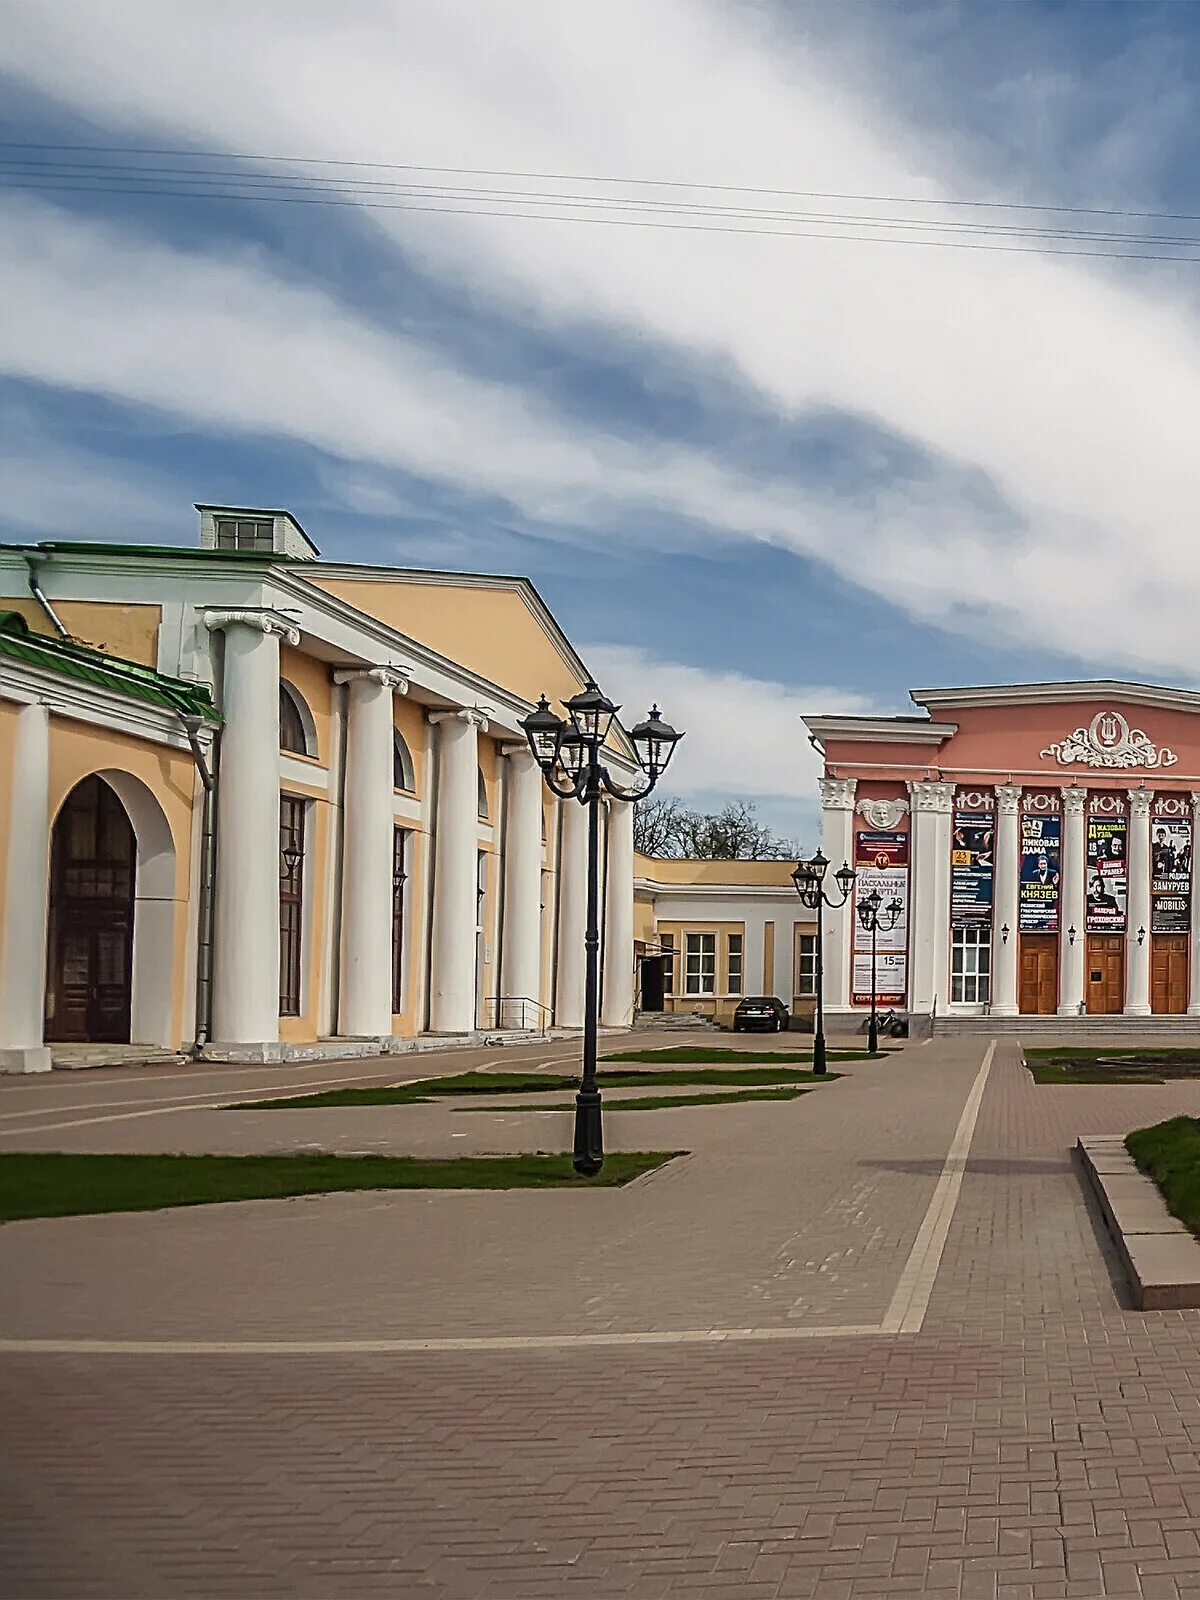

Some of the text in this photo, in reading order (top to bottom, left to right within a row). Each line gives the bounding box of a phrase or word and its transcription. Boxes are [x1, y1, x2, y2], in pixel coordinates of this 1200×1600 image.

[1022, 839, 1060, 847] ПИКОВАЯ
[1021, 847, 1047, 855] ДАМА
[1152, 881, 1190, 891] ЗАМУРУЕВ
[858, 888, 898, 896] КОНЕРТЫ
[1020, 890, 1059, 899] КНЯЗЕВ
[883, 956, 895, 966] 15
